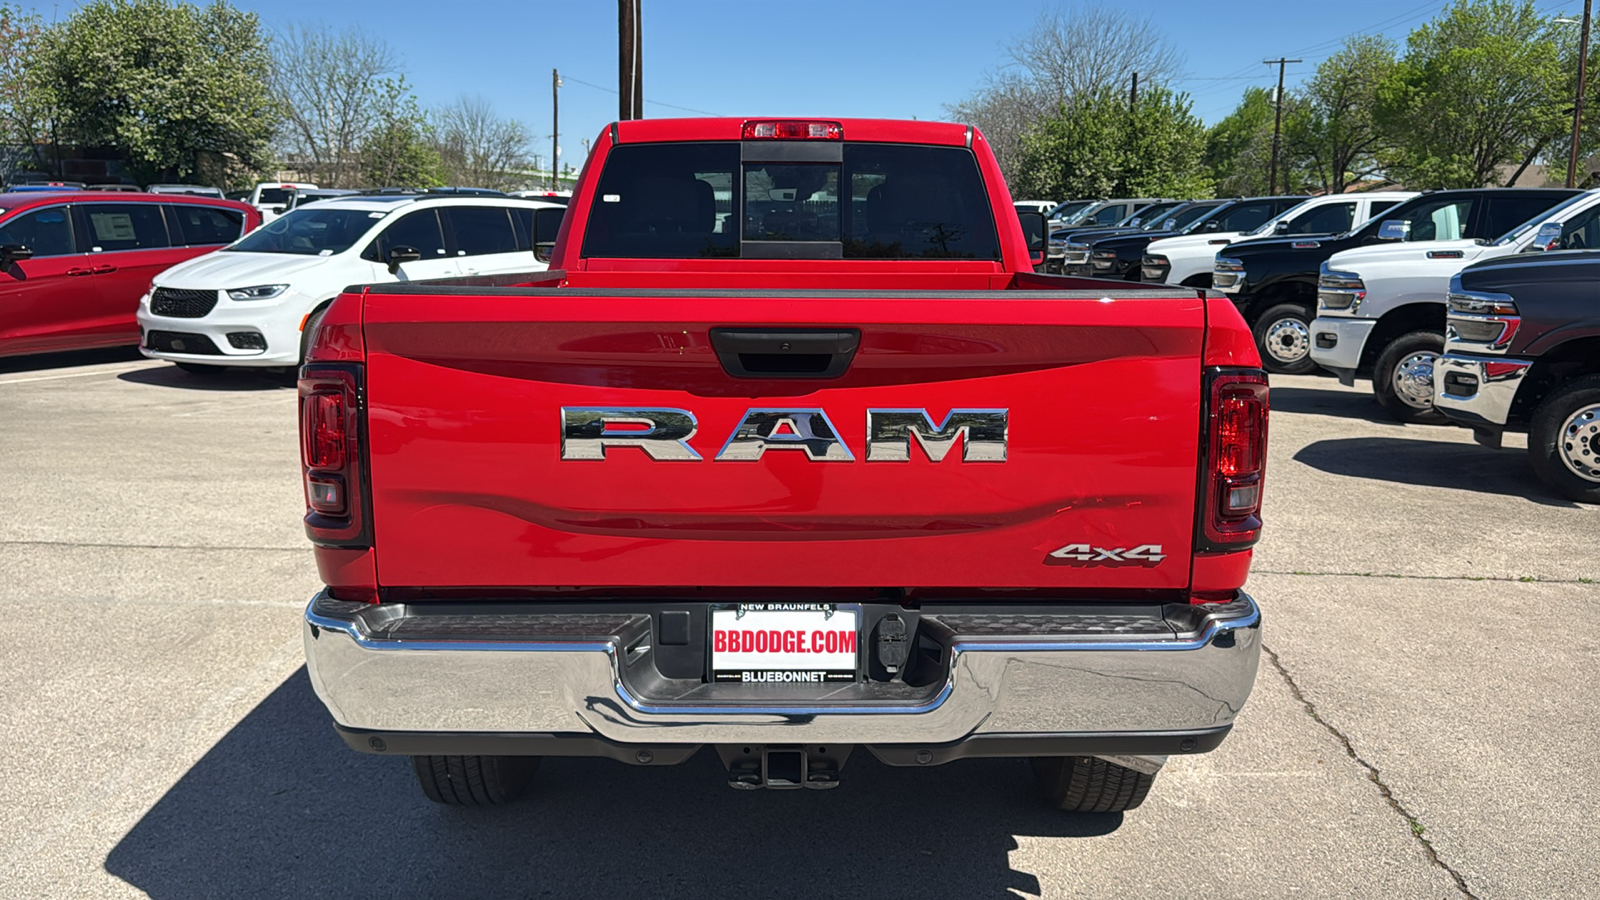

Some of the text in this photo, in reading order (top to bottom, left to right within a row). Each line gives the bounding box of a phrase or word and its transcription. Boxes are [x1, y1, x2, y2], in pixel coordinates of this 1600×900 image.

[560, 406, 1009, 462] RAM
[1049, 543, 1167, 562] 4x4
[741, 603, 831, 611] NEW BRAUNFELS
[714, 630, 856, 653] BBDODGE.COM
[742, 671, 827, 683] BLUEBONNET
